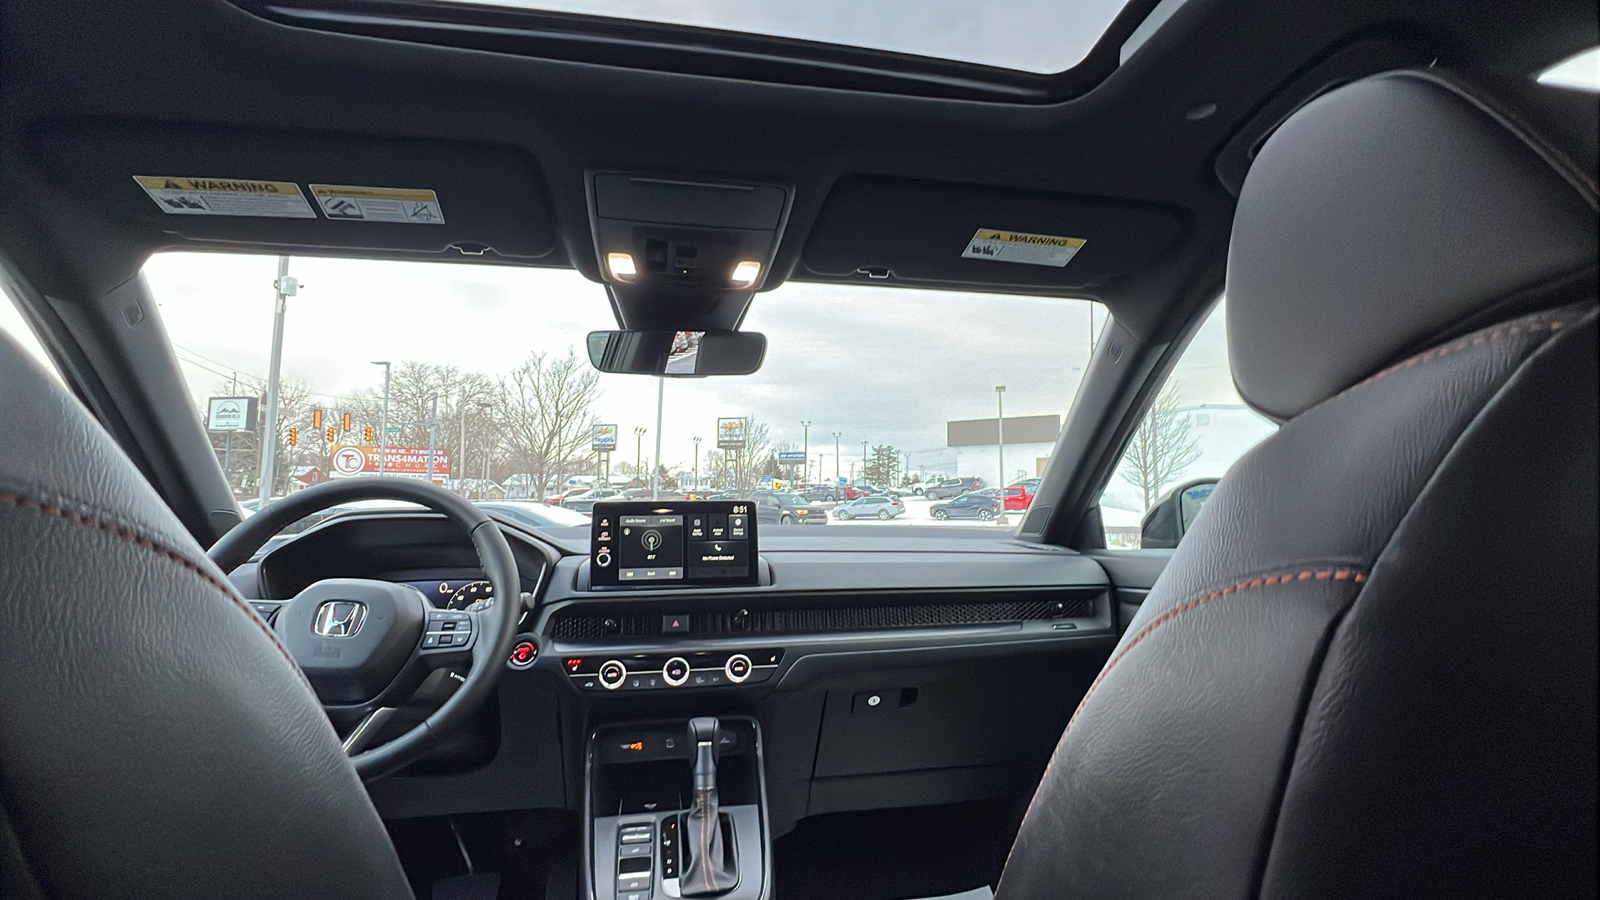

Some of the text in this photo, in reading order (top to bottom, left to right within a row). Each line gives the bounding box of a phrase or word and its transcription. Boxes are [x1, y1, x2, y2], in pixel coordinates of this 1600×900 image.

[187, 179, 279, 193] WARNING
[1009, 233, 1068, 246] WARNING
[367, 453, 448, 464] TRANS4MATON
[733, 505, 748, 514] 8:51
